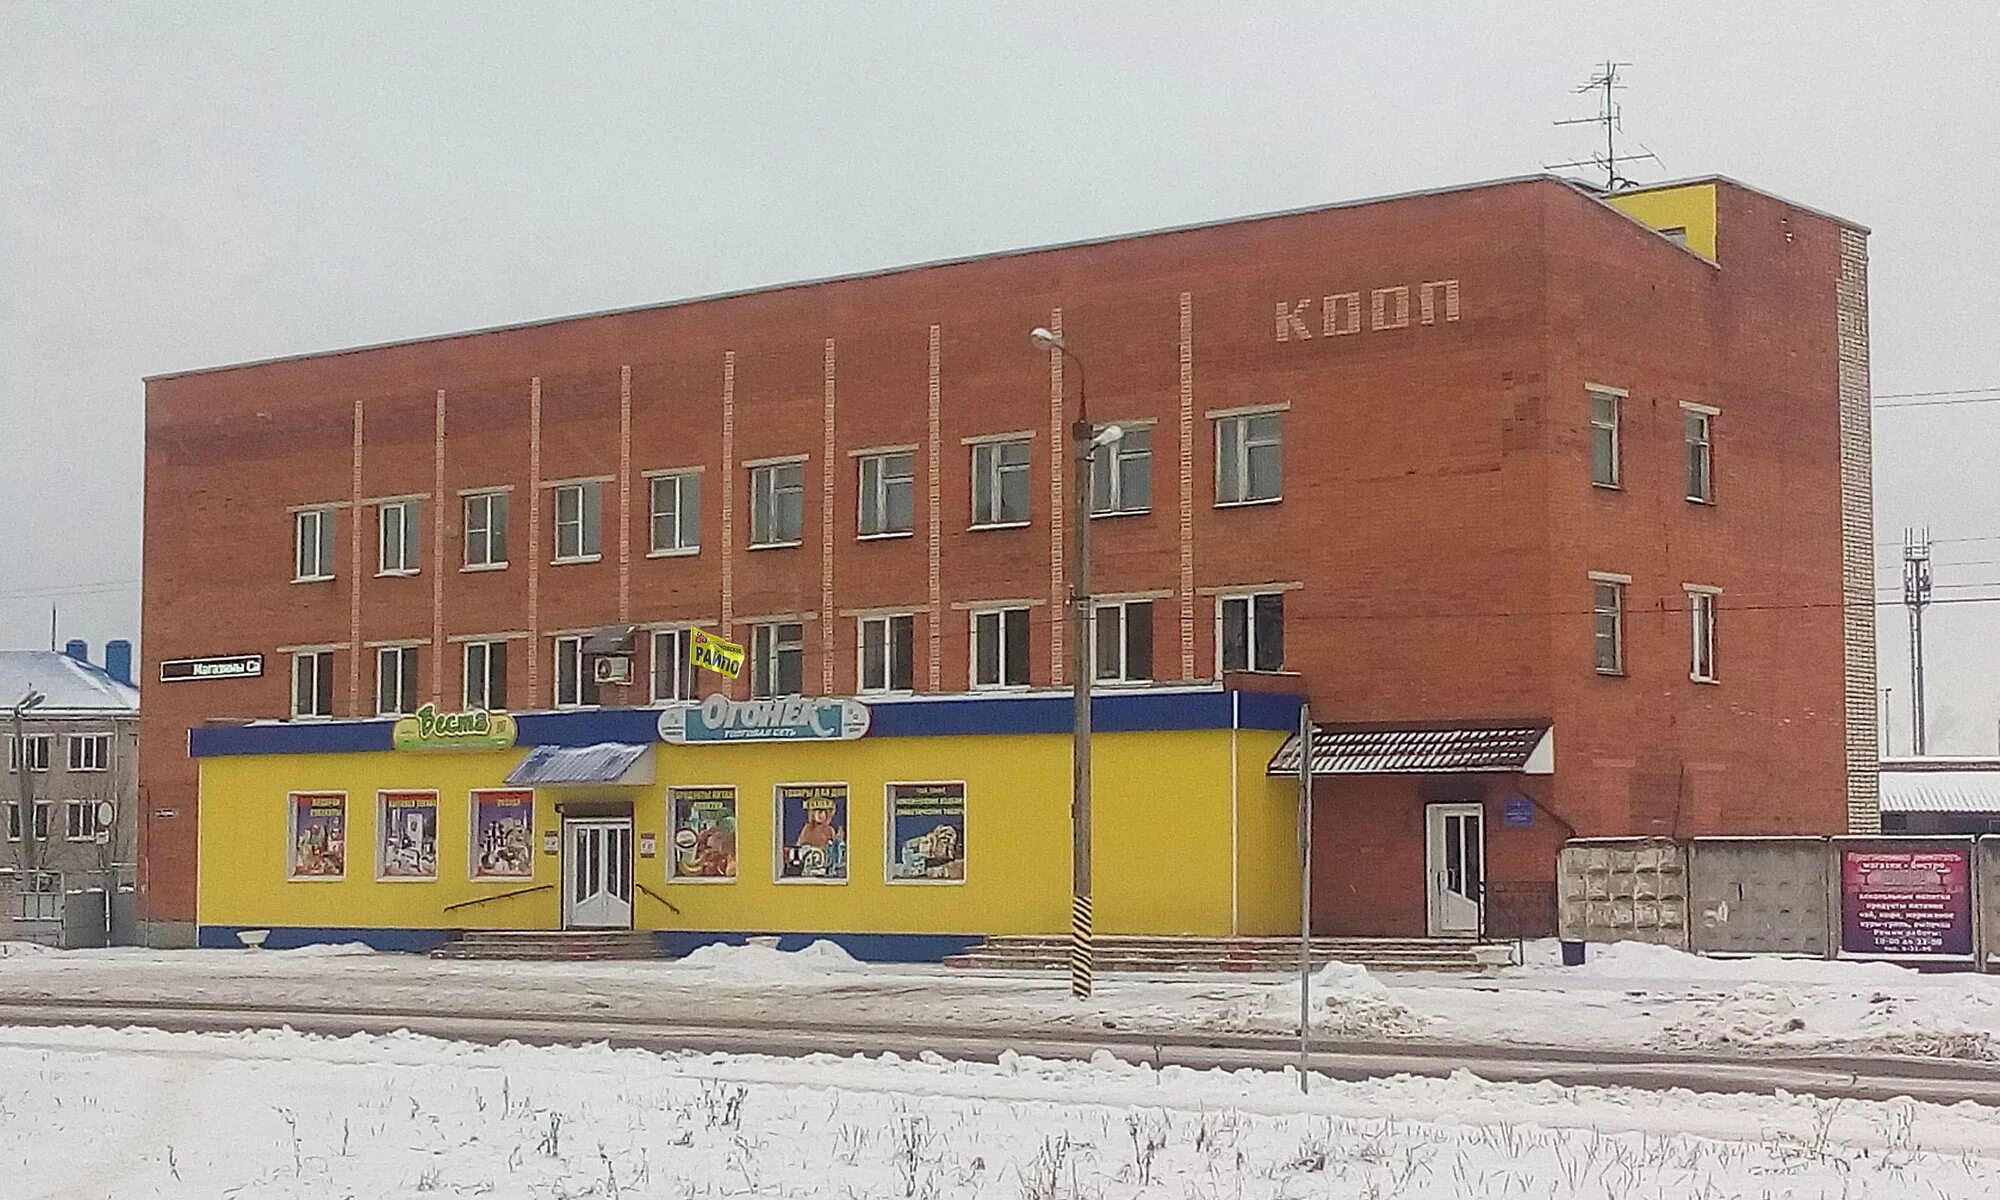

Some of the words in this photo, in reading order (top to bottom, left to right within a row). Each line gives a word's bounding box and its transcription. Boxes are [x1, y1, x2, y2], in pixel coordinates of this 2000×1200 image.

[1276, 279, 1460, 343] КООП
[193, 663, 245, 676] Магазины
[695, 646, 740, 675] РАЙПО
[773, 727, 797, 737] СЕТЬ
